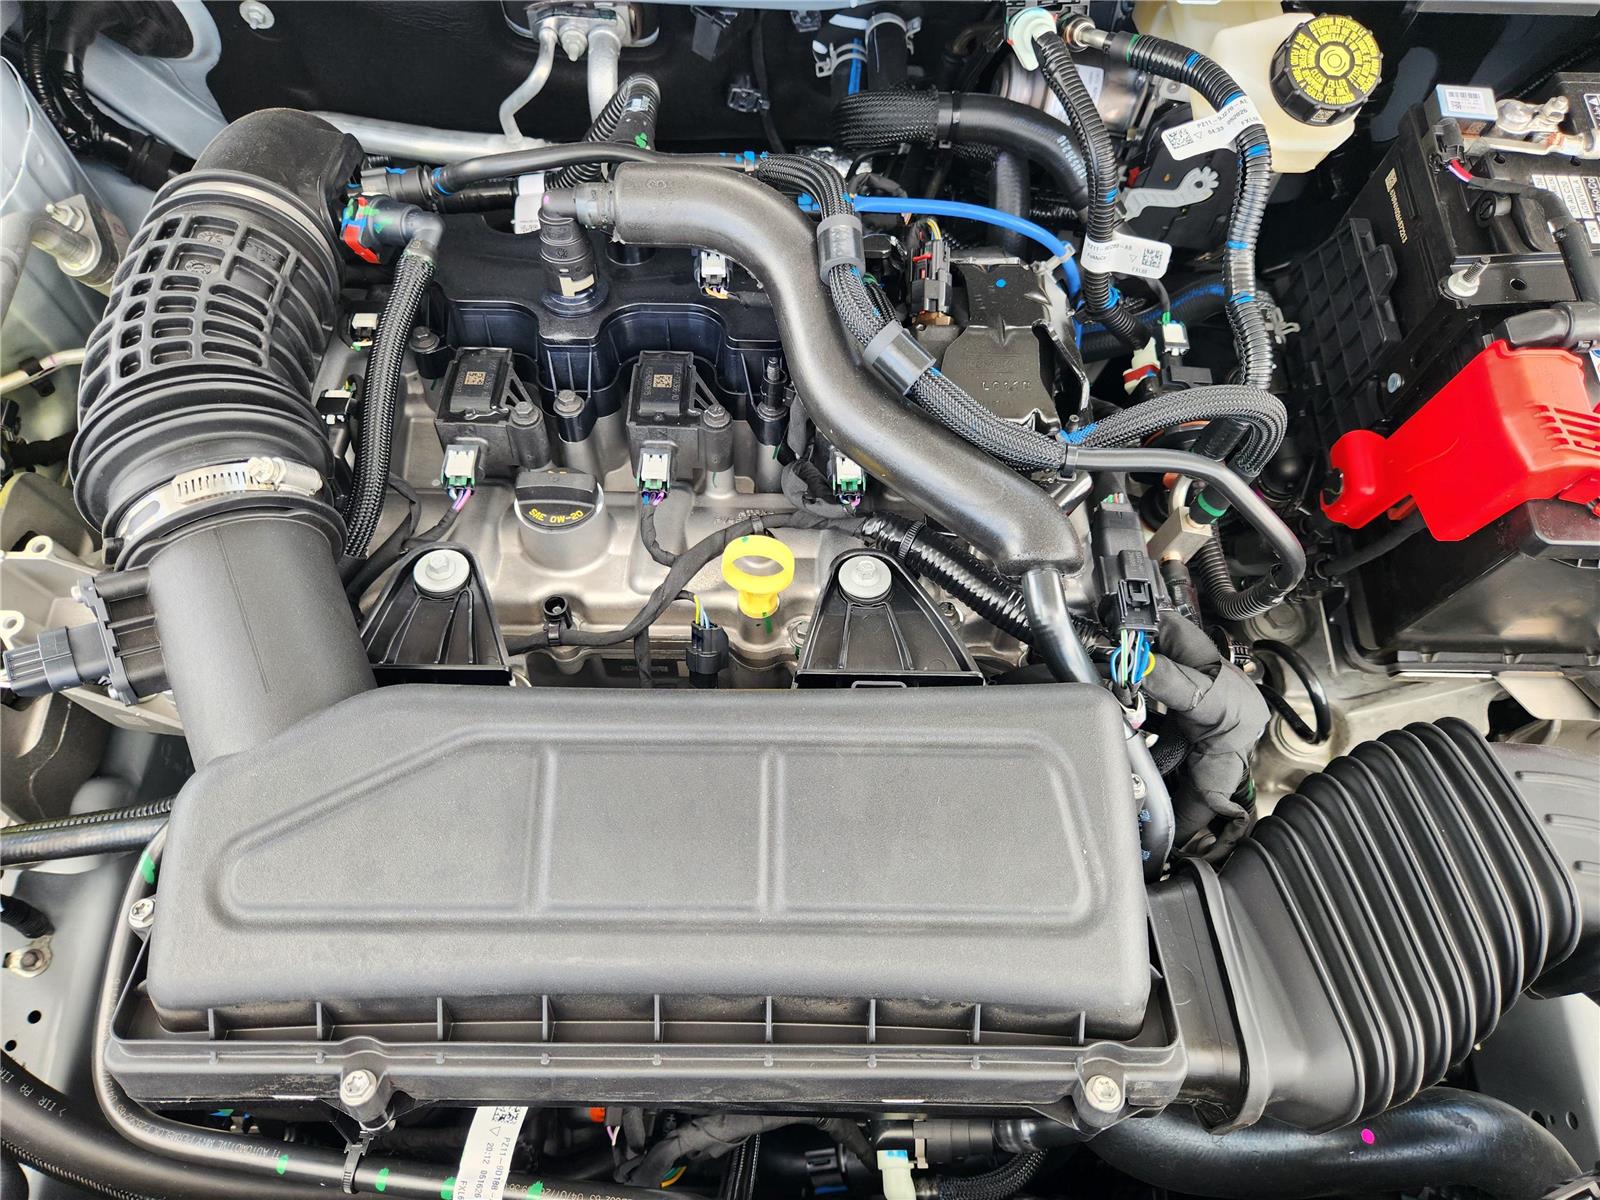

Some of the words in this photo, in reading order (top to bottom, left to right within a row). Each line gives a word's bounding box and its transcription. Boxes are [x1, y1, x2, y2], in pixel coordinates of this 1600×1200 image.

[1309, 68, 1326, 85] CLEAN
[1326, 77, 1347, 88] FILLER
[528, 508, 547, 521] SAE
[550, 510, 584, 523] 0W-20
[218, 1139, 272, 1159] AUTOMOTIVE
[483, 1142, 495, 1165] 20:12
